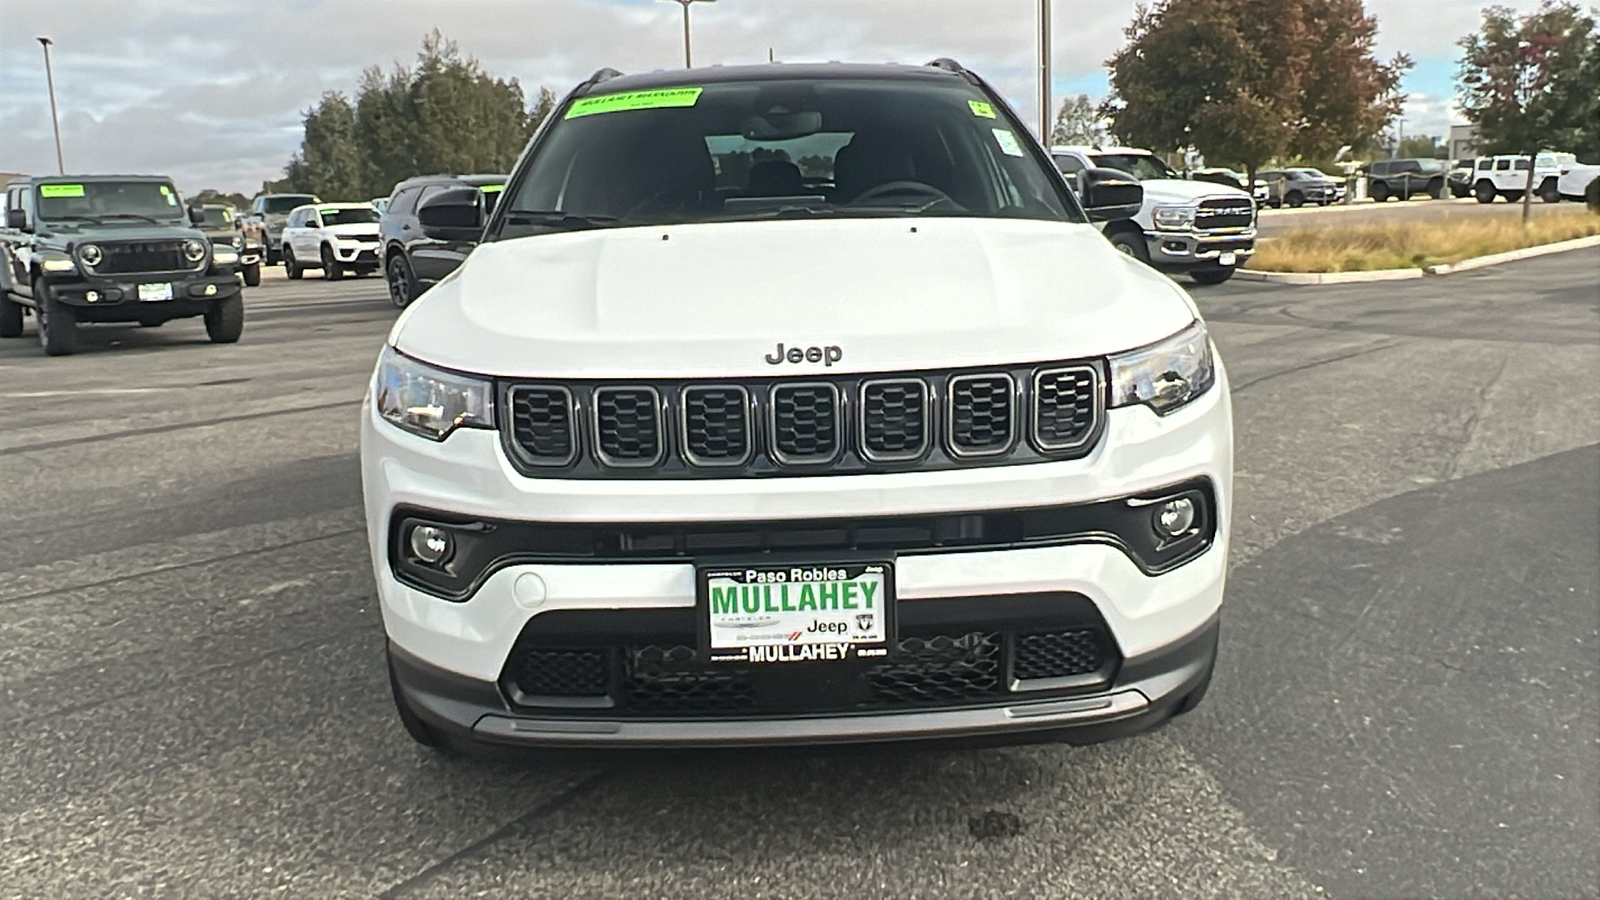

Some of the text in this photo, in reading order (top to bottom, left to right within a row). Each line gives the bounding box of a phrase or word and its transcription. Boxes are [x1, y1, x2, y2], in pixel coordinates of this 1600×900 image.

[765, 343, 842, 367] Jeep
[746, 567, 847, 583] Paso Robles
[712, 581, 878, 614] MULLAHEY
[807, 619, 848, 635] Jeep
[749, 643, 849, 662] MULLAHEY
